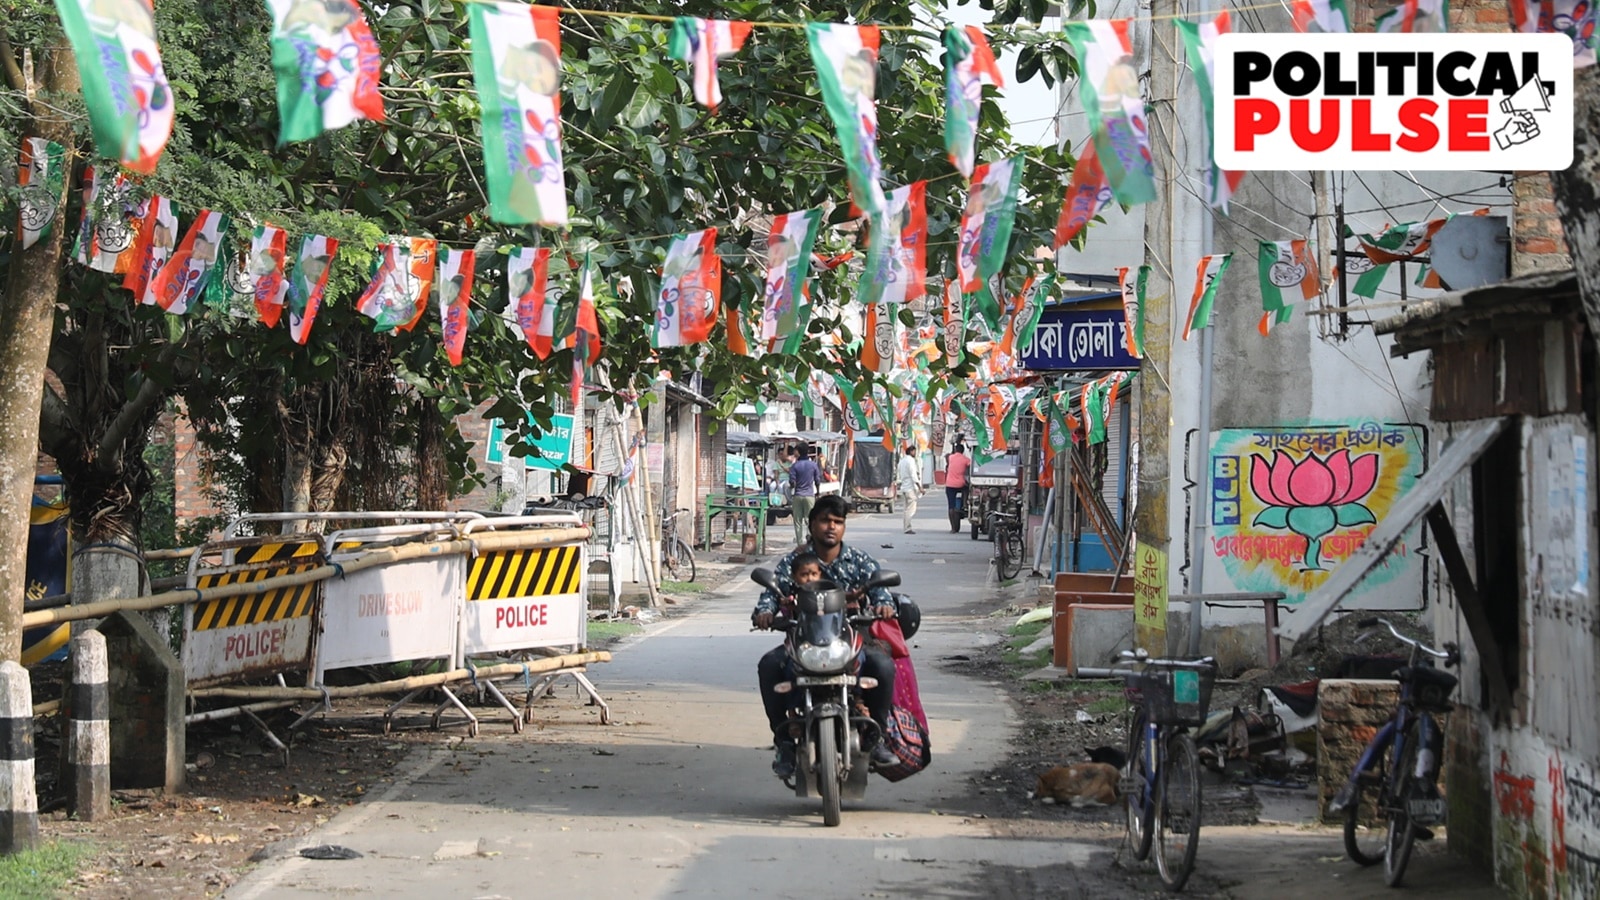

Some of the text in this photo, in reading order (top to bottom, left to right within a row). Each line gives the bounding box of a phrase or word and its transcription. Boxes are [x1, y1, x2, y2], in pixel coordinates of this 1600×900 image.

[1068, 318, 1115, 364] তোলা
[1343, 421, 1406, 449] প্রতীক
[1213, 456, 1240, 525] BJP
[358, 589, 424, 618] DRIVE SLOW
[496, 604, 548, 629] POLICE
[225, 628, 280, 661] POLICE
